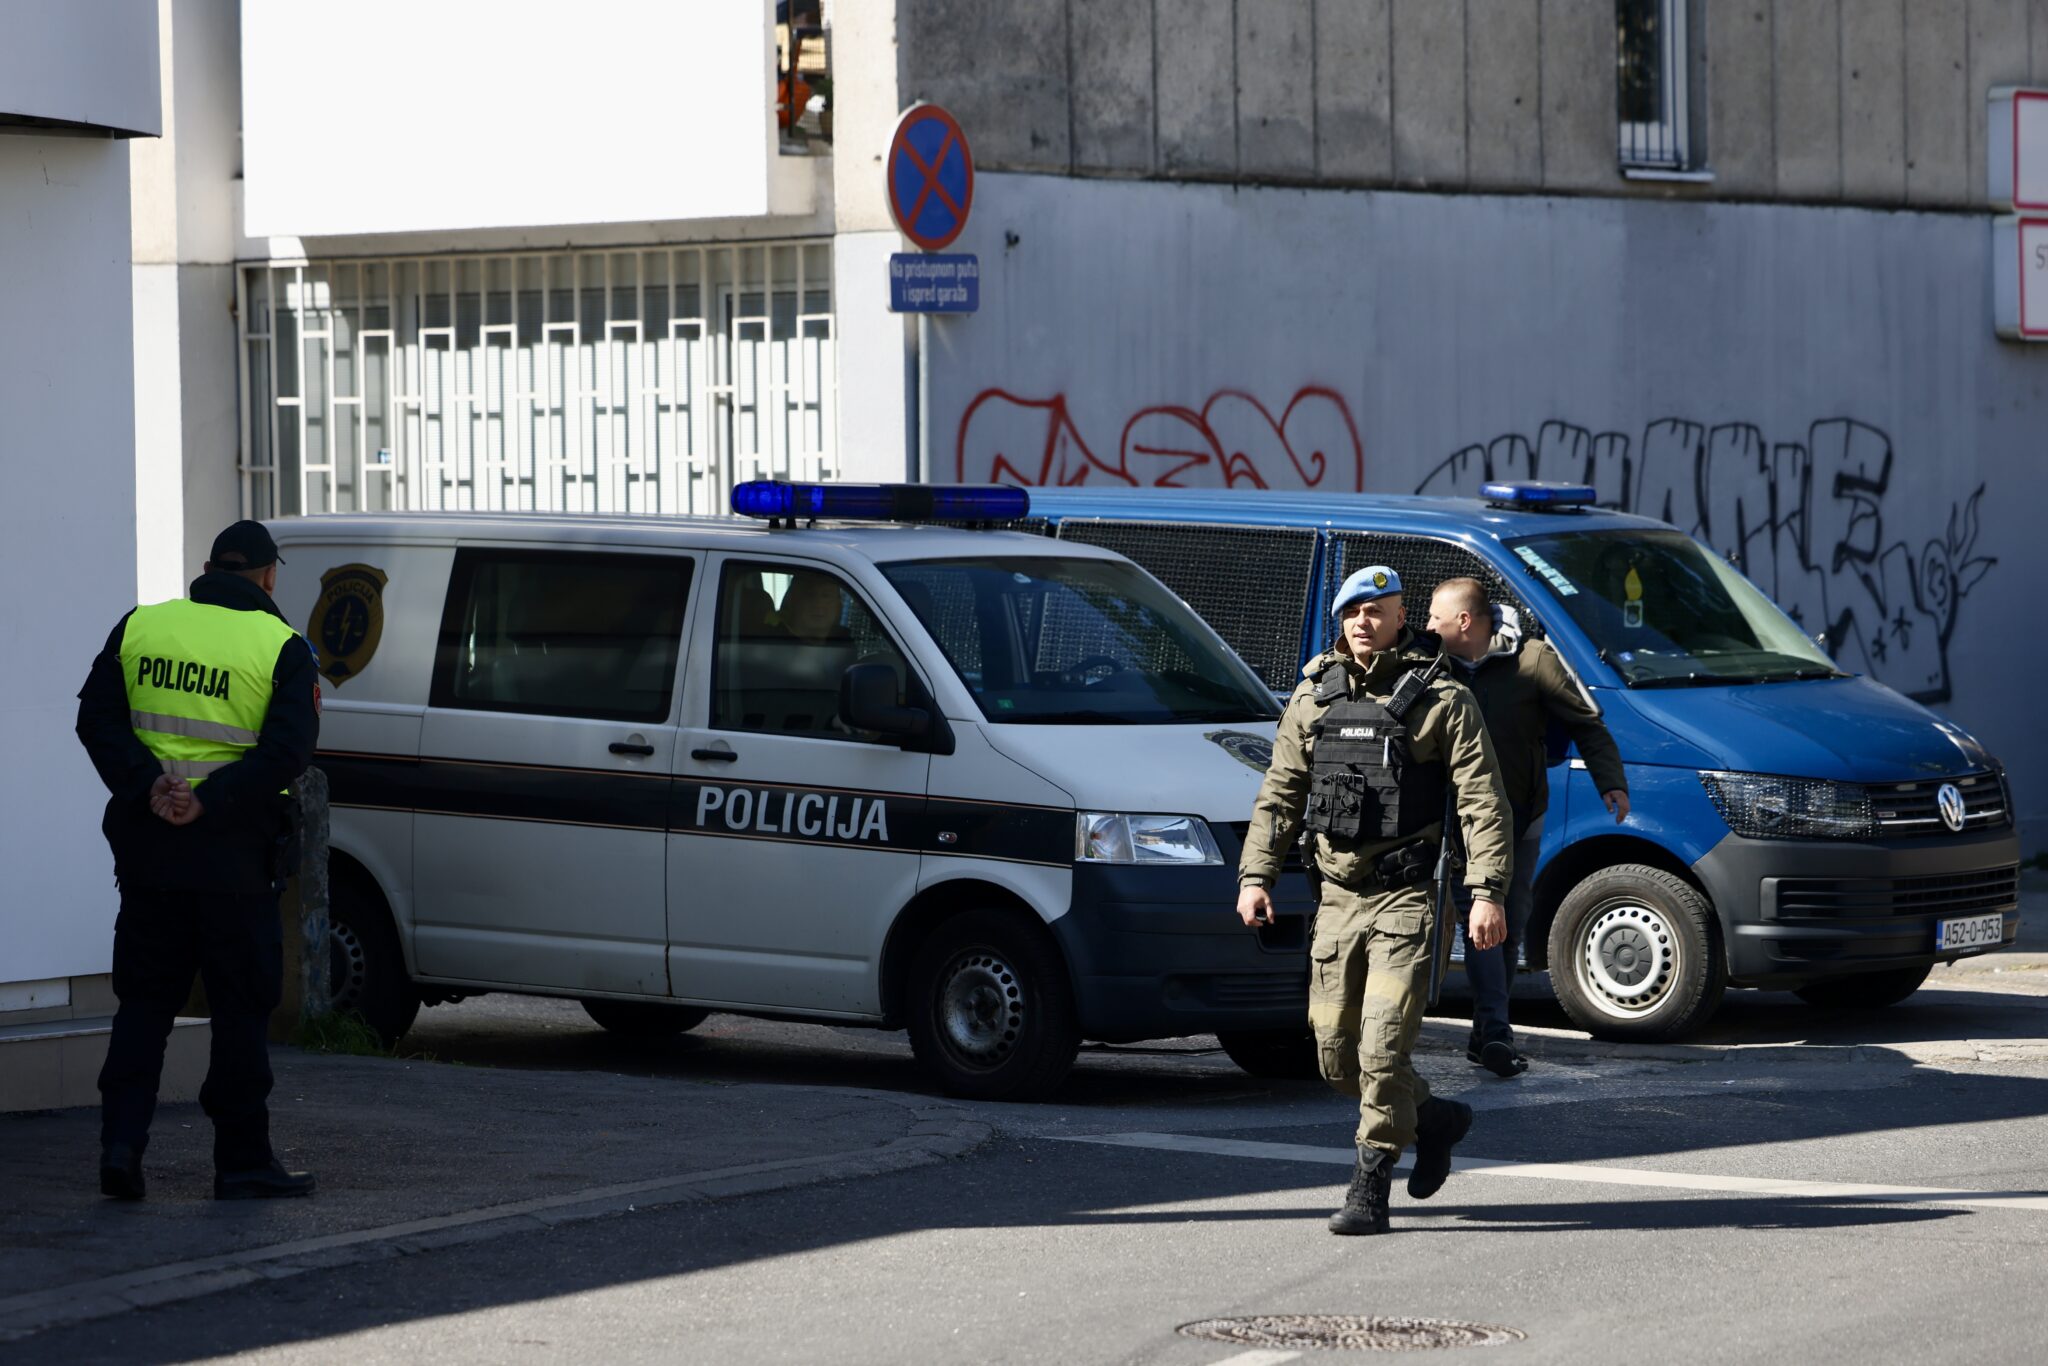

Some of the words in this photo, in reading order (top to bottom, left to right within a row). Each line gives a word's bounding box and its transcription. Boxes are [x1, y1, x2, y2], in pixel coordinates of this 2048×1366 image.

[138, 656, 230, 700] POLICIJA
[1340, 727, 1375, 738] POLICIJA
[696, 785, 889, 841] POLICIJA
